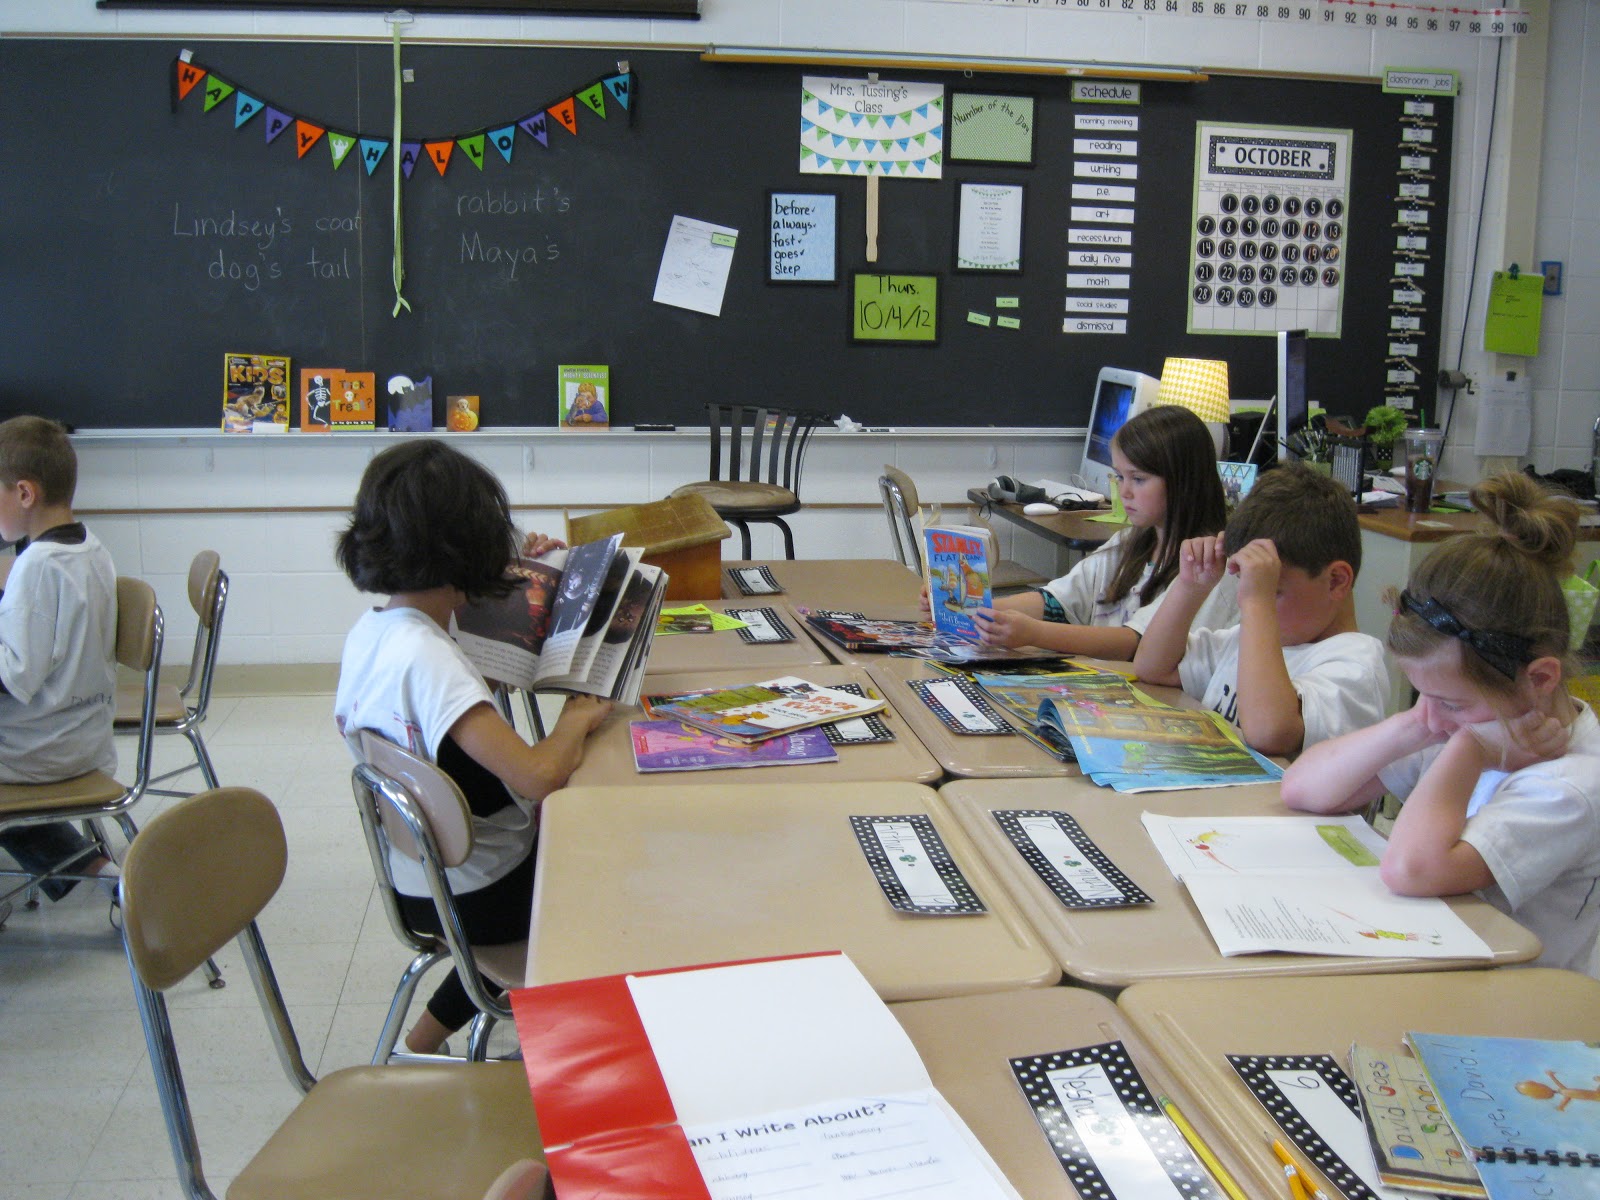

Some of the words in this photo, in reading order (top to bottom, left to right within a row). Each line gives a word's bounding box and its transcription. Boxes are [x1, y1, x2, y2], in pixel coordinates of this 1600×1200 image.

[1122, 0, 1134, 9] 82
[1144, 0, 1156, 10] 83
[1166, 0, 1178, 12] 84
[1192, 2, 1204, 13] 85
[1214, 3, 1226, 14] 86
[1235, 4, 1247, 16] 87
[1256, 6, 1268, 17] 88
[1278, 7, 1290, 18] 89
[1298, 8, 1310, 20] 90
[1324, 10, 1334, 22] 91
[1344, 12, 1356, 24] 92
[1366, 14, 1377, 26] 93
[1386, 15, 1398, 27] 94
[1406, 17, 1418, 29] 95
[1426, 19, 1438, 31] 96
[1448, 20, 1460, 32] 97
[1469, 22, 1481, 34] 98
[1491, 22, 1504, 34] 99
[1512, 22, 1528, 34] 100
[1389, 74, 1429, 86] classroom
[1433, 76, 1450, 88] jobs
[830, 83, 855, 96] Mrs.
[861, 84, 908, 102] Tussing's
[1080, 85, 1132, 99] schedule
[854, 100, 883, 113] Class
[182, 68, 312, 148] HAPPY
[366, 80, 628, 164] HALLOWEEN
[952, 104, 984, 126] Number
[988, 99, 998, 110] of
[1001, 103, 1014, 118] the
[1015, 114, 1030, 136] Day
[1080, 118, 1105, 126] morning
[1108, 118, 1133, 128] meeting
[1089, 140, 1122, 152] reading
[1234, 146, 1312, 167] OCTOBER
[1090, 164, 1121, 176] writing
[1096, 188, 1111, 196] p.e.
[457, 187, 570, 216] rabbit's
[774, 198, 810, 216] before
[1096, 210, 1110, 218] art
[174, 202, 292, 250] Lindsey's
[316, 210, 361, 232] coat
[772, 218, 812, 236] always
[1266, 222, 1276, 234] 10
[1287, 224, 1295, 234] 11
[772, 232, 796, 248] fast
[462, 232, 560, 278] Maya's
[774, 250, 799, 264] goes
[1202, 242, 1211, 254] 14
[1223, 243, 1233, 256] 15
[1244, 245, 1254, 257] 16
[1264, 246, 1275, 257] 17
[1287, 248, 1296, 260] 18
[1080, 254, 1098, 266] daily
[1104, 254, 1120, 264] five
[208, 249, 282, 290] dog's
[306, 248, 350, 278] tail
[774, 262, 800, 276] sleep
[1199, 266, 1209, 279] 21
[1221, 266, 1233, 279] 22
[1242, 268, 1252, 281] 23
[1262, 268, 1273, 280] 24
[1283, 270, 1294, 282] 25
[1304, 270, 1314, 282] 26
[1325, 271, 1336, 283] 27
[871, 275, 920, 294] Thurs.
[1086, 276, 1110, 286] math
[1197, 287, 1208, 300] 28
[1219, 290, 1231, 302] 29
[1240, 291, 1252, 304] 30
[1262, 291, 1272, 302] 31
[1096, 302, 1118, 310] studies
[860, 300, 932, 332] 10/4/12
[1076, 322, 1114, 332] dismissal
[230, 364, 284, 384] KIDS
[339, 380, 365, 390] Trick
[934, 554, 956, 562] FLAT
[1366, 1060, 1396, 1096] Goes
[1432, 1043, 1495, 1102] David!
[688, 1136, 711, 1148] an
[718, 1132, 729, 1143] I
[735, 1122, 796, 1138] Write
[804, 1102, 888, 1128] About?
[1372, 1104, 1424, 1160] David
[1435, 1148, 1462, 1166] to
